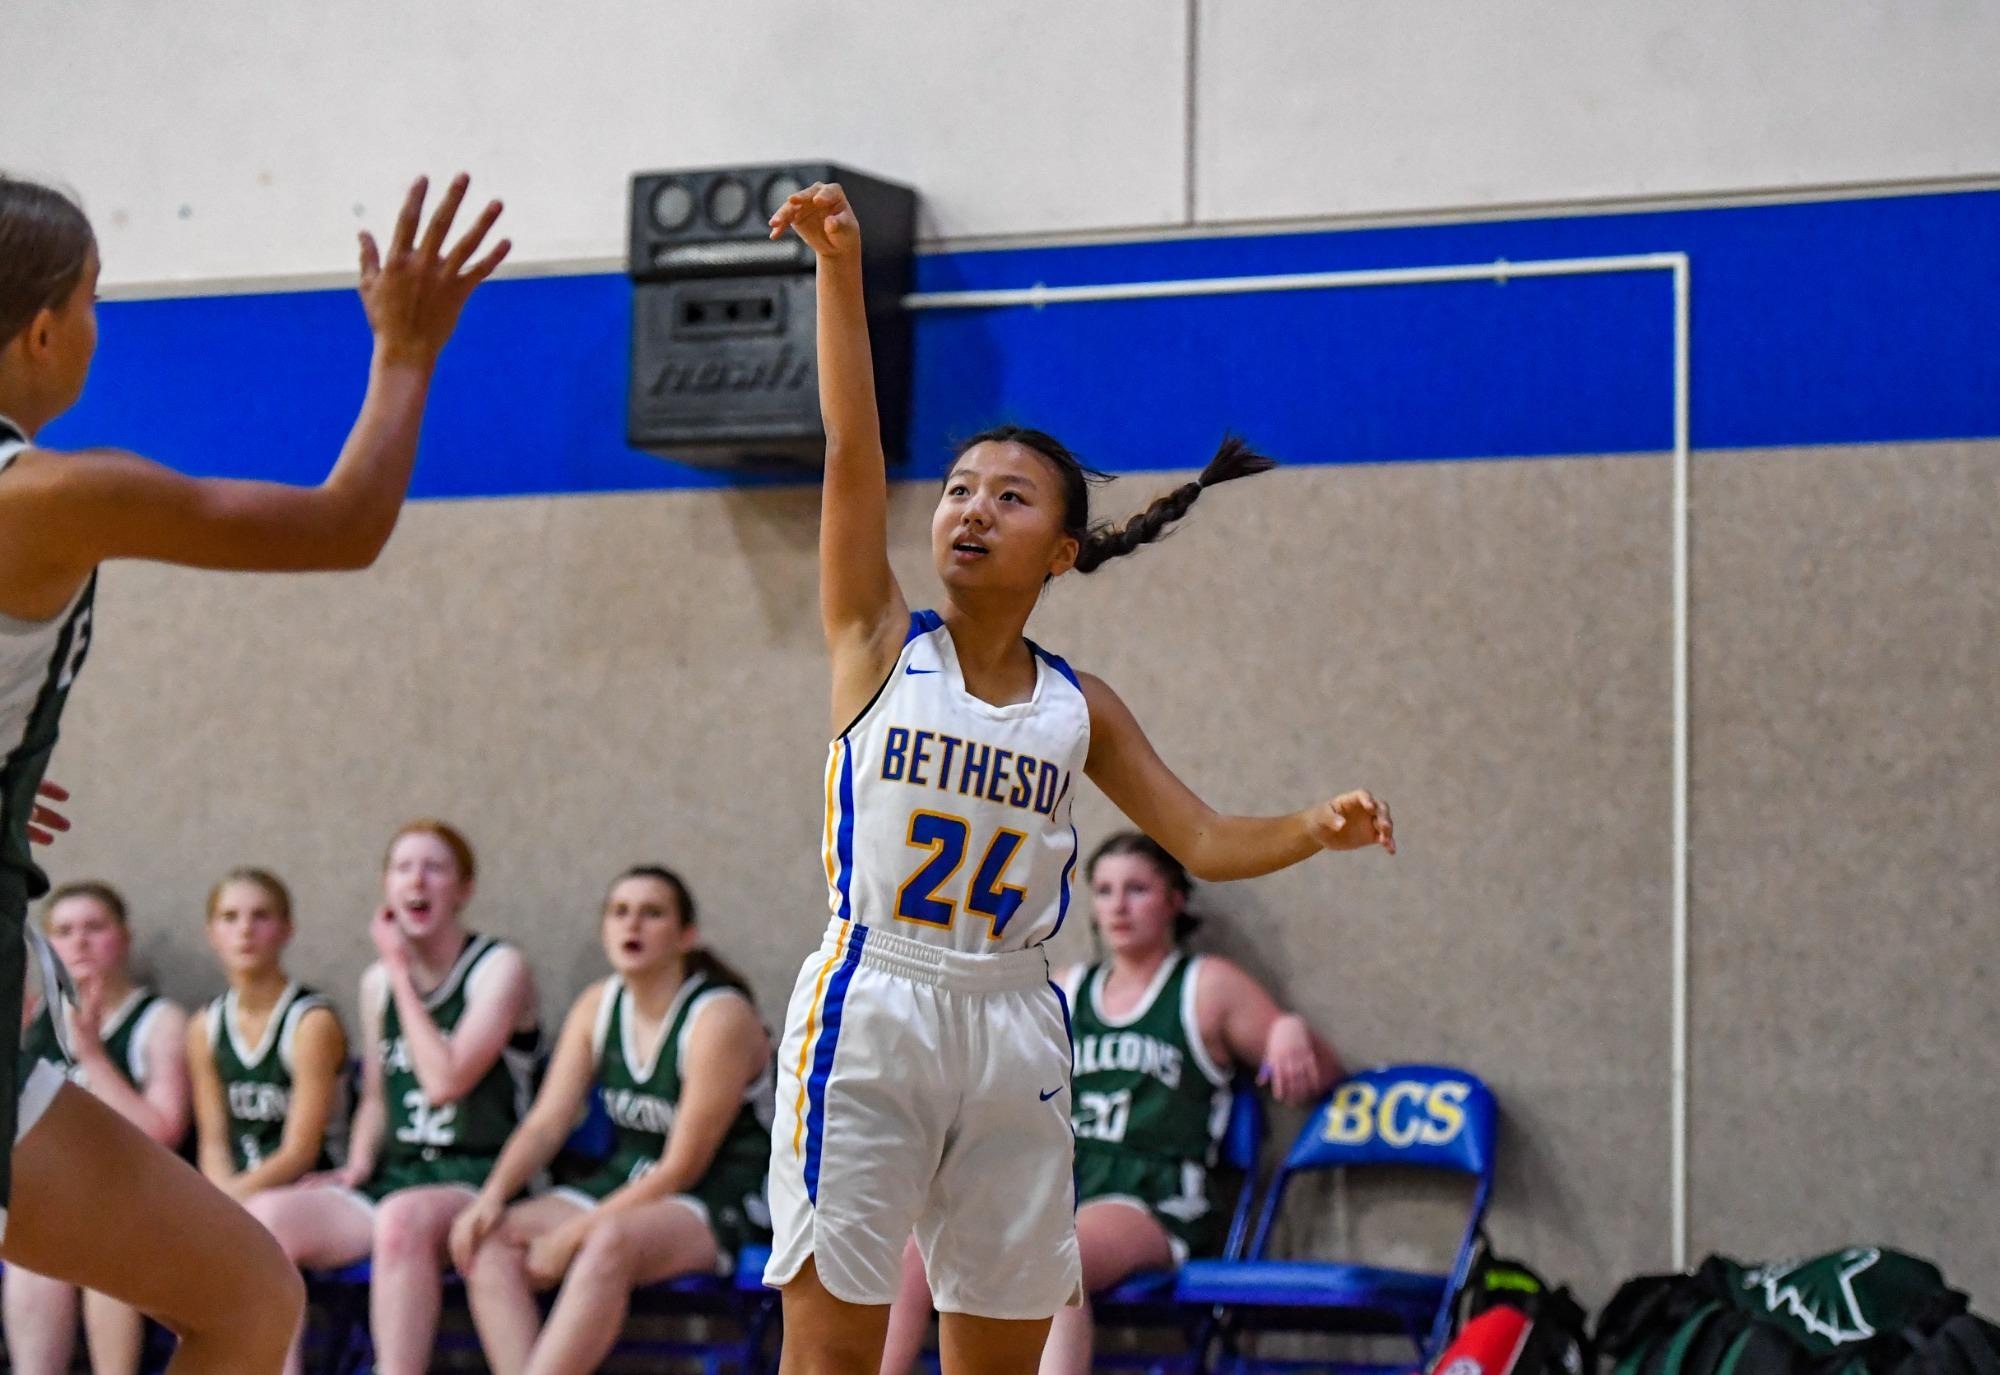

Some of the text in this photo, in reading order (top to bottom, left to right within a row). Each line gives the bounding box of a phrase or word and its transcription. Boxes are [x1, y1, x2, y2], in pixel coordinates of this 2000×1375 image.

[880, 725, 1071, 825] BETHESD
[893, 808, 1028, 941] 24
[1319, 1079, 1472, 1149] BCS
